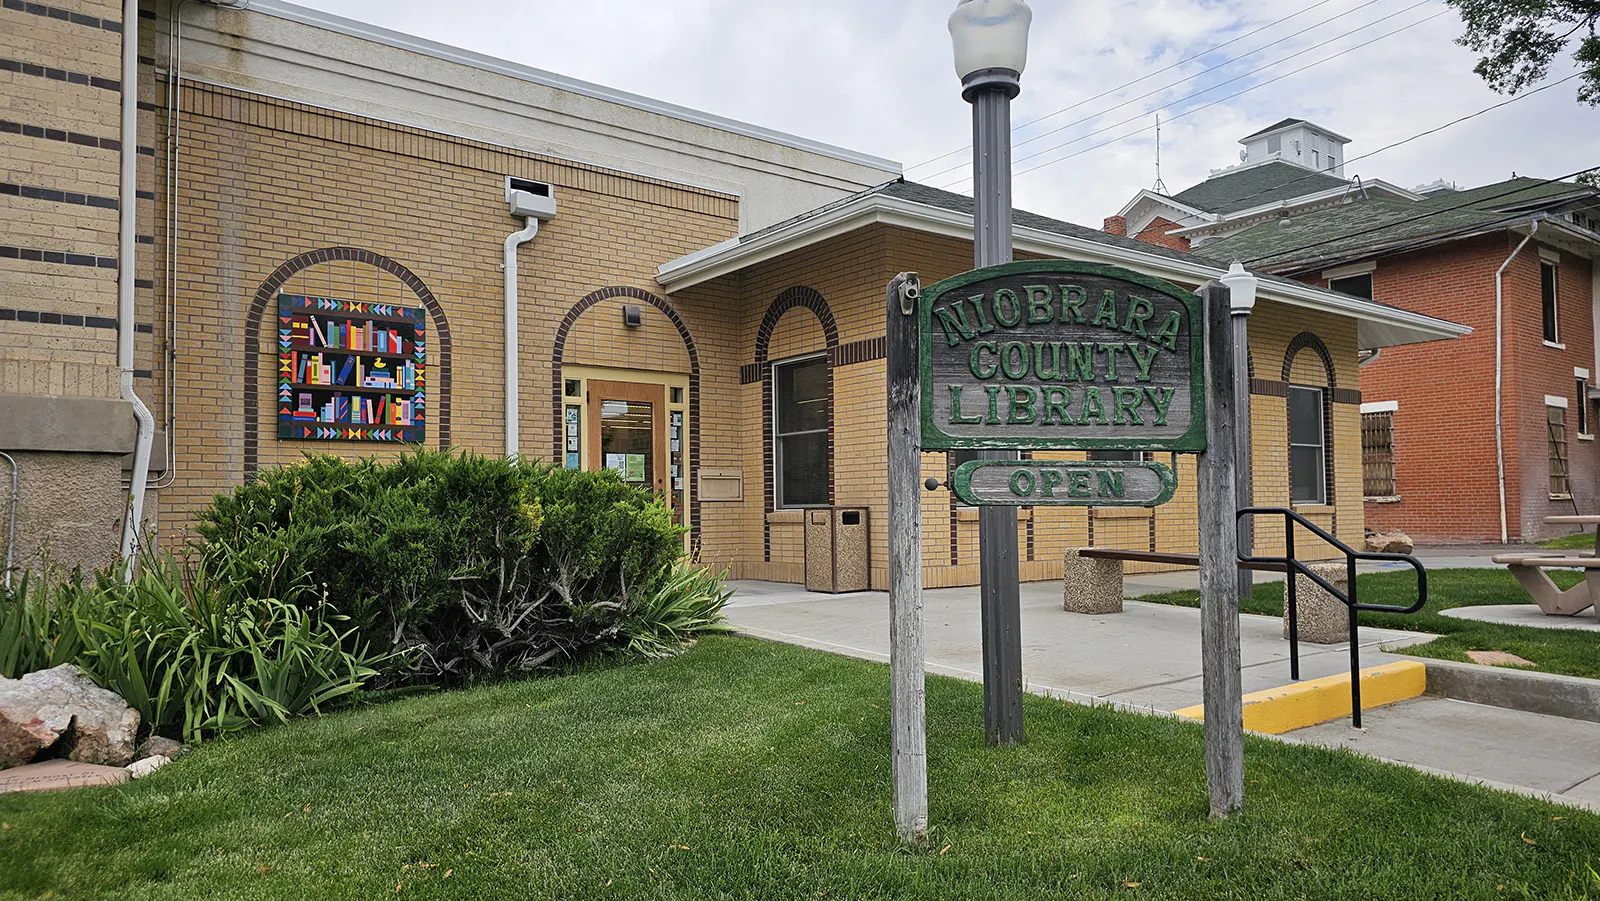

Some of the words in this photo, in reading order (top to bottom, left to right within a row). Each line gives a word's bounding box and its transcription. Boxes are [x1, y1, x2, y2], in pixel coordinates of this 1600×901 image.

[933, 284, 1181, 351] NIOBRARA
[969, 340, 1159, 382] COUNTY
[948, 385, 1176, 426] LIBRARY
[1009, 469, 1126, 497] OPEN
